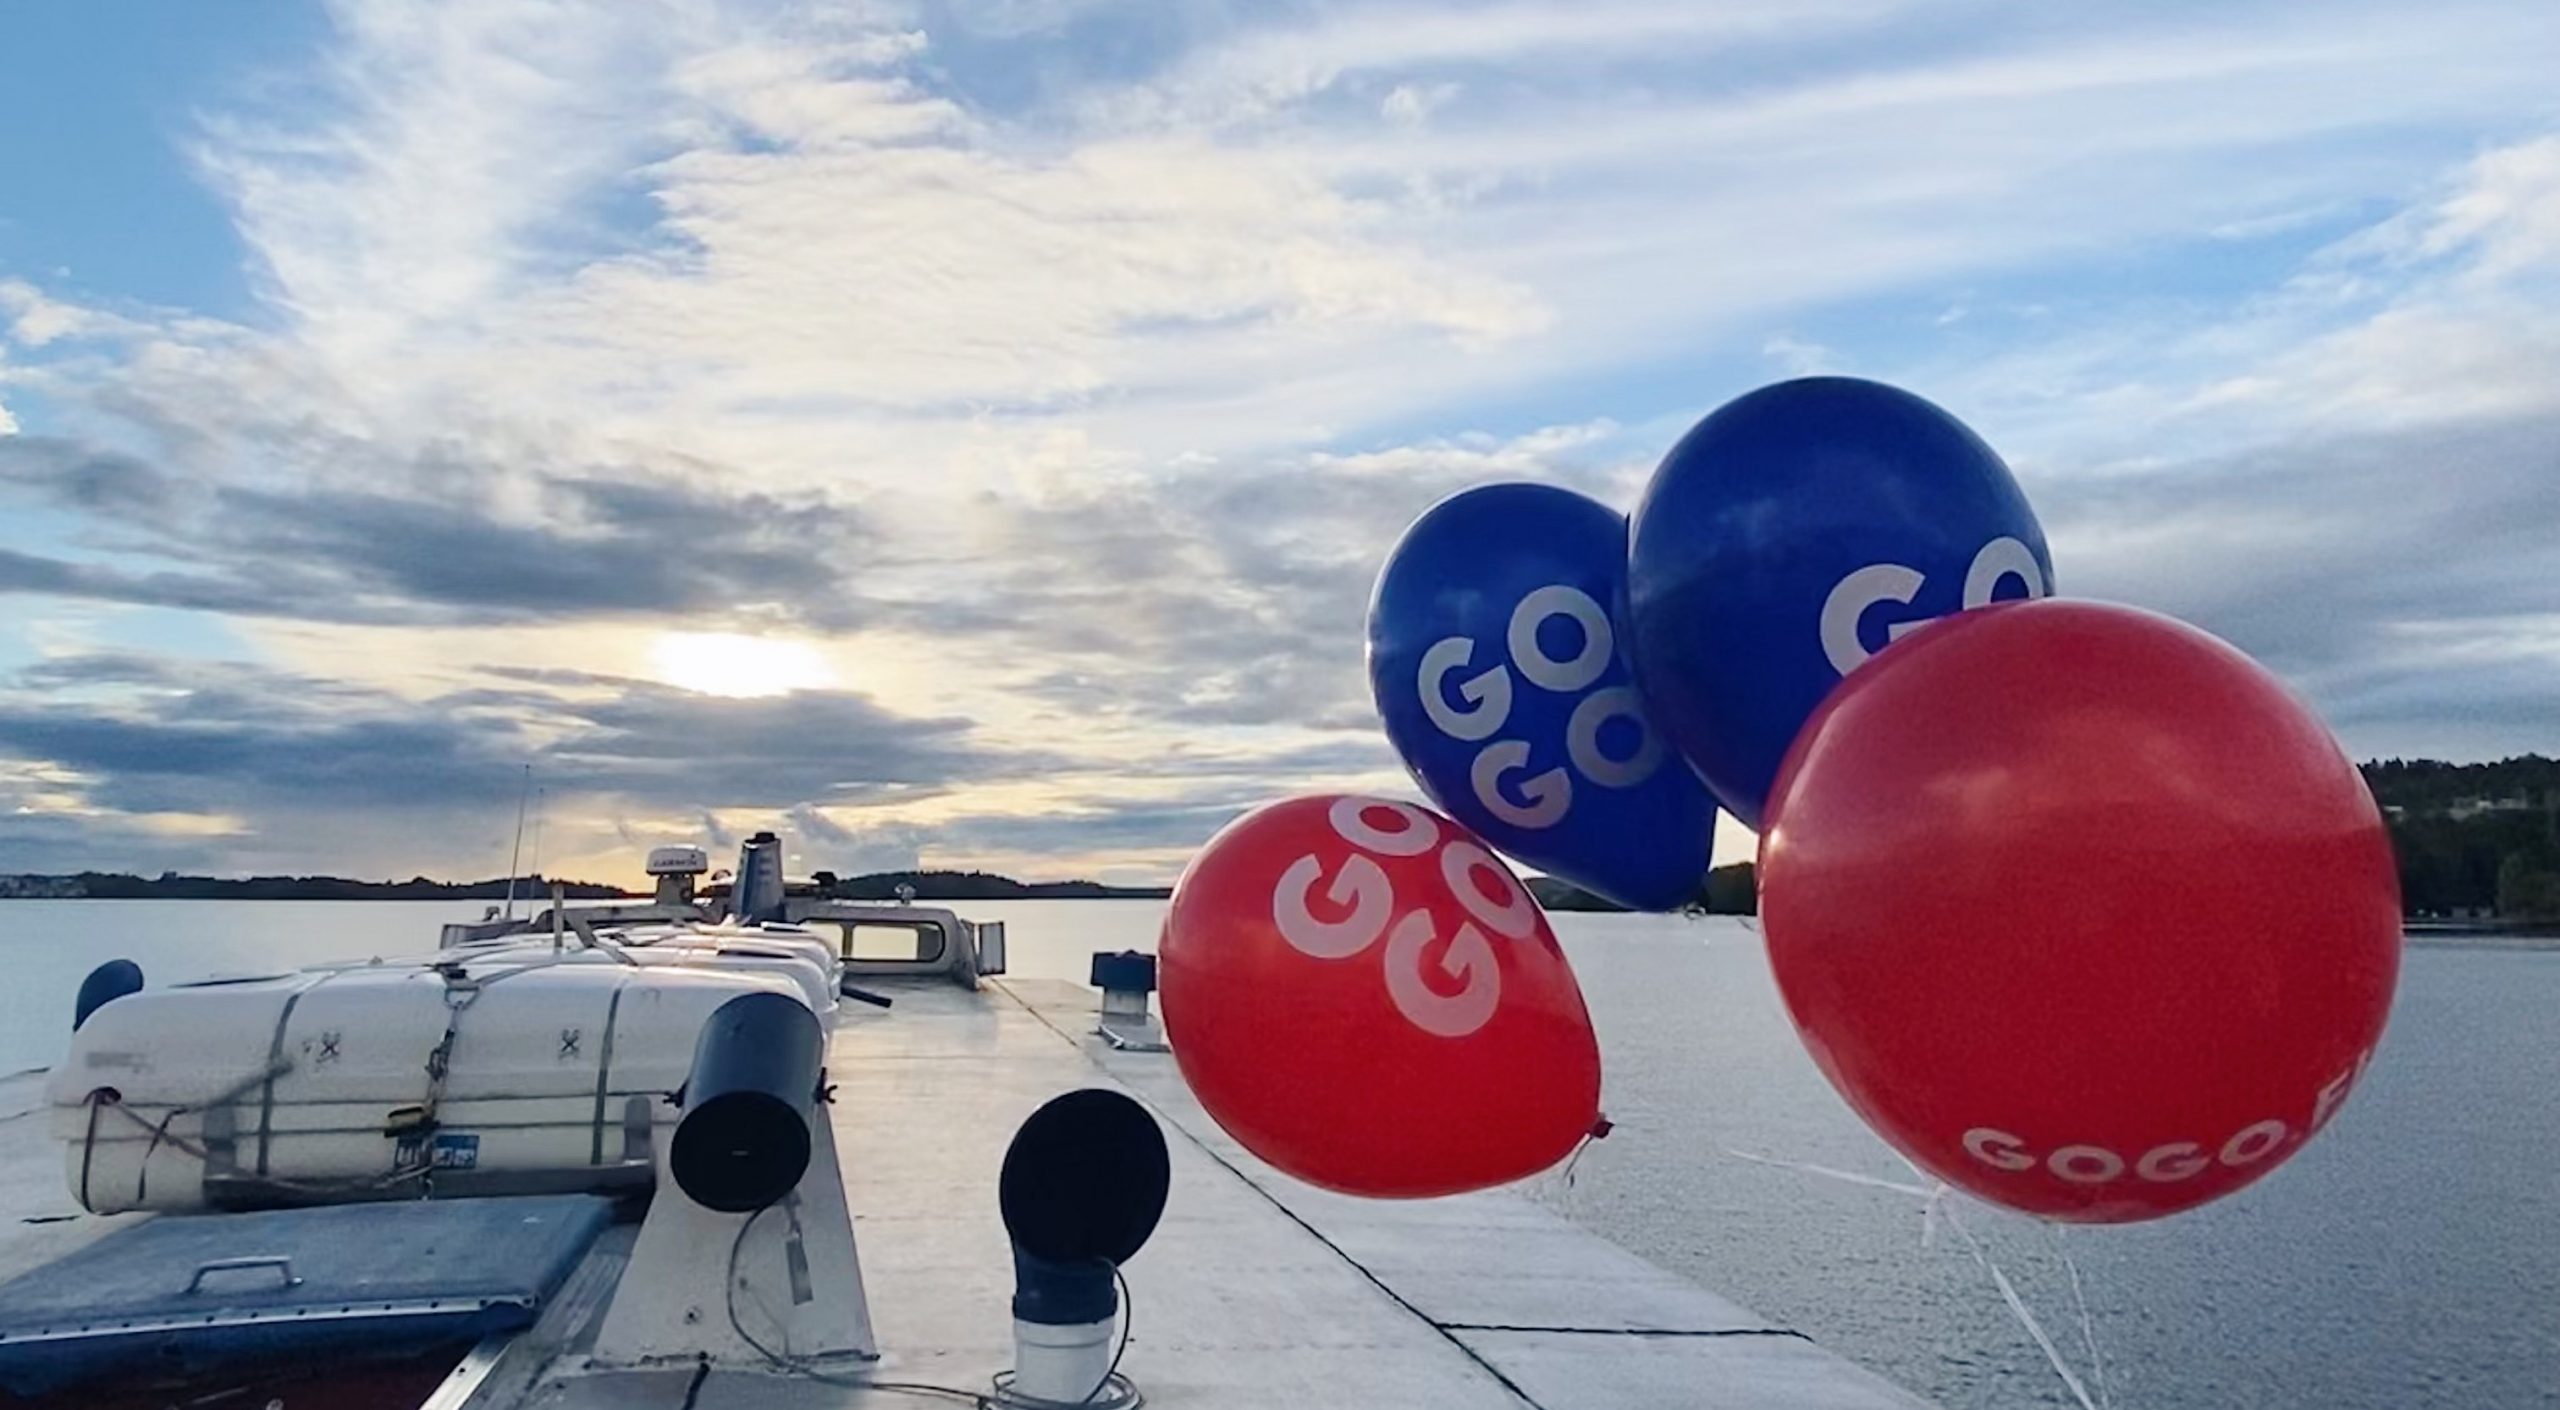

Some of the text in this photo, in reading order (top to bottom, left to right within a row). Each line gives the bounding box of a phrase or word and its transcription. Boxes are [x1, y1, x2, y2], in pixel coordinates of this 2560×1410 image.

[1418, 584, 1613, 741] GO
[1471, 686, 1665, 829] GO
[1273, 796, 1439, 958] GO
[1385, 841, 1536, 1037] GO
